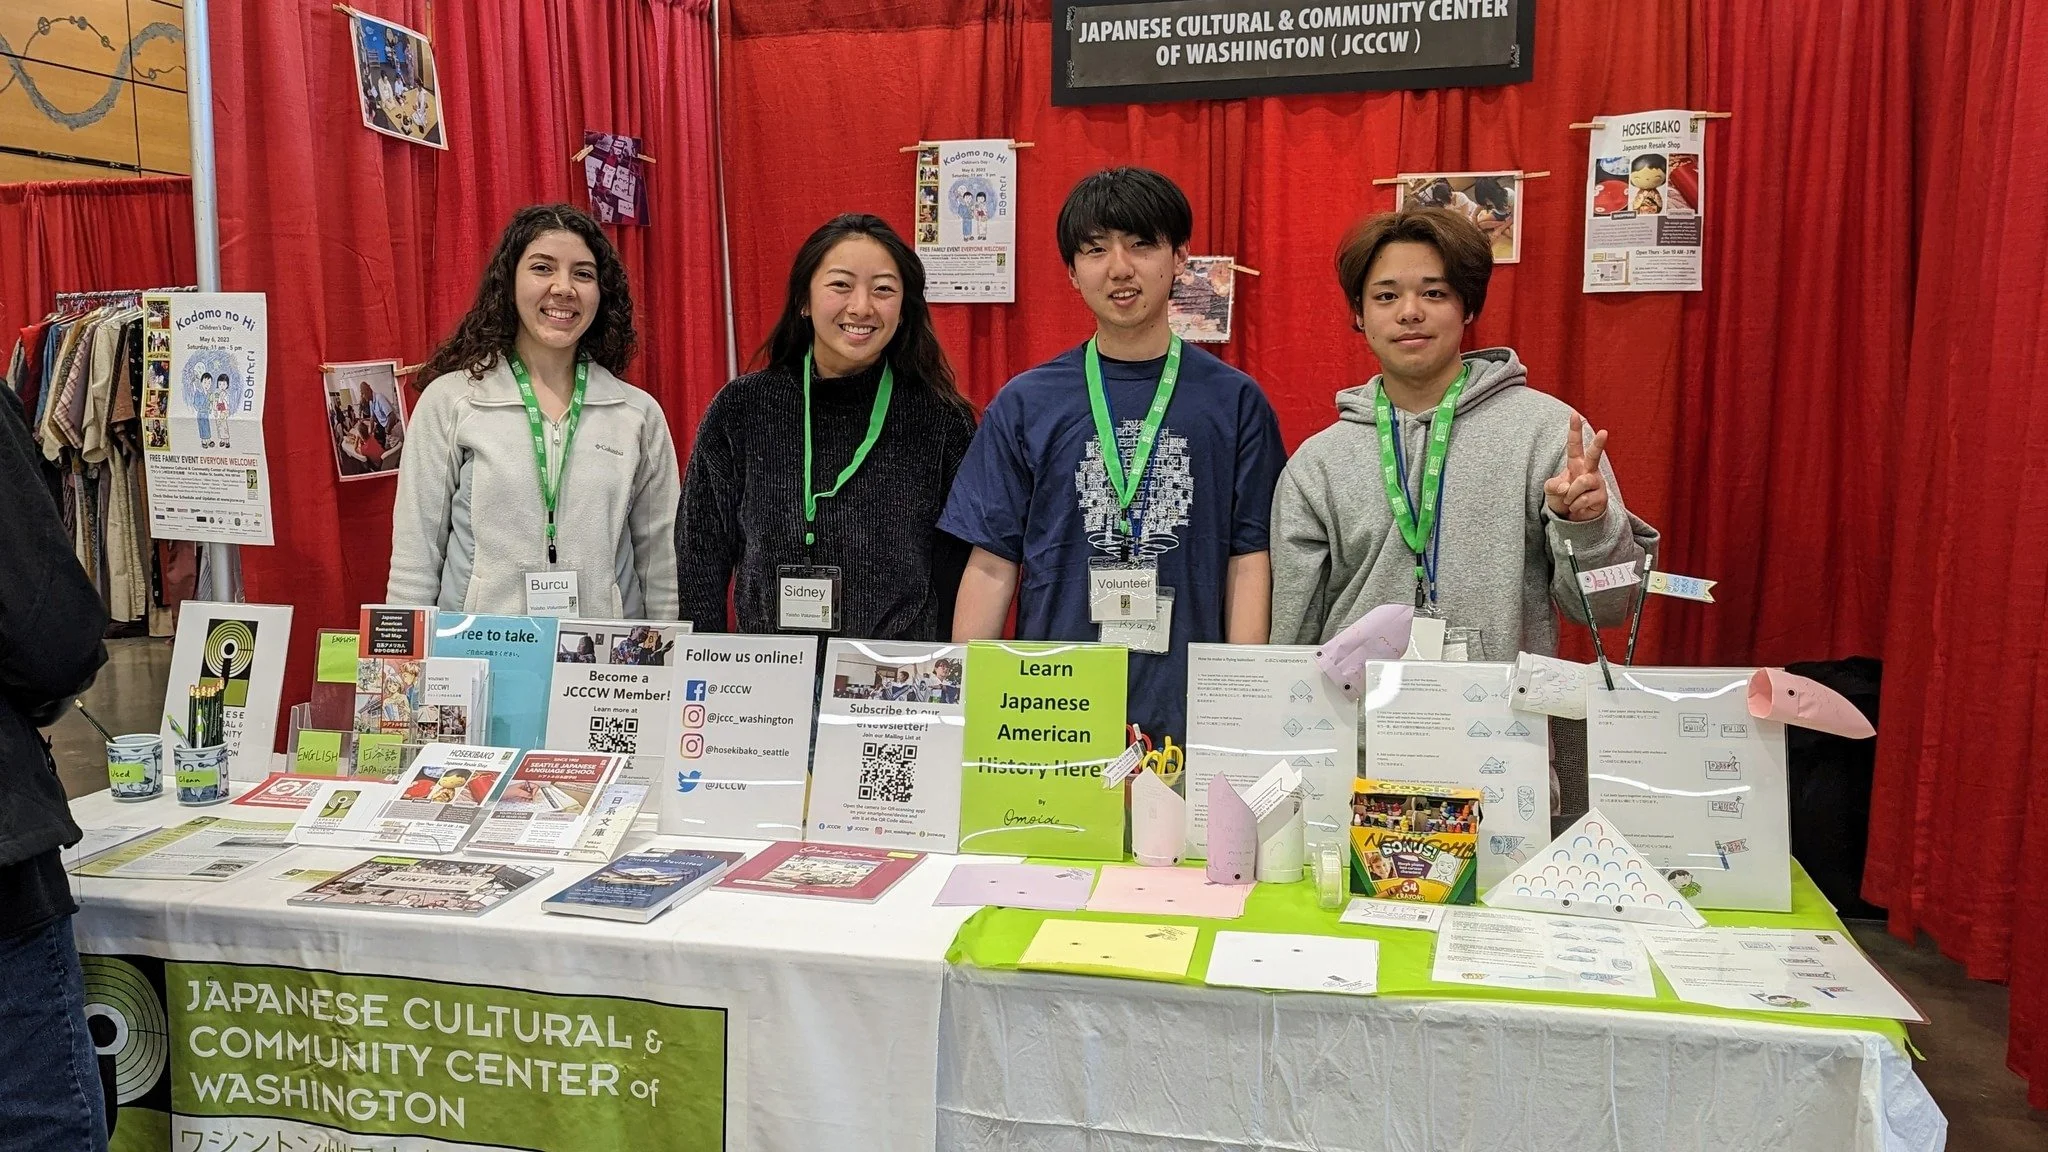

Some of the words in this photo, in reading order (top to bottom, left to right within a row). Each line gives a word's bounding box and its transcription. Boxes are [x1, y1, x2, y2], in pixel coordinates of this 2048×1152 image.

[1078, 18, 1171, 43] JAPANESE
[1176, 11, 1274, 35] CULTURAL
[1278, 9, 1295, 32] &
[1298, 0, 1424, 30] COMMUNITY
[1428, 0, 1508, 22] CENTER
[1156, 44, 1181, 66] OF
[1186, 36, 1325, 64] WASHINGTON
[1341, 32, 1409, 56] JCCCW
[1621, 120, 1681, 137] HOSEKIBAKO
[1622, 143, 1647, 152] Japanese
[1649, 141, 1666, 149] Resale
[1667, 141, 1681, 149] Shop
[943, 150, 980, 165] Kodomo
[997, 154, 1008, 165] Hi
[998, 175, 1008, 216] こどもの日
[176, 309, 221, 331] Kodomo
[225, 310, 239, 322] no
[242, 315, 256, 331] Hi
[243, 350, 256, 412] こどもの日
[149, 454, 161, 462] FREE
[162, 454, 181, 463] FAMILY
[181, 455, 199, 465] EVENT
[200, 456, 228, 466] EVERYONE
[229, 458, 258, 467] WELCOME!
[531, 579, 568, 590] Burcu
[1098, 579, 1151, 589] Volunteer
[784, 585, 826, 600] Sidney
[454, 630, 483, 641] ree
[487, 629, 501, 641] to
[505, 629, 538, 643] take.
[685, 649, 731, 663] Follow
[735, 653, 750, 663] us
[754, 651, 804, 664] online!
[1019, 659, 1073, 677] Learn
[589, 670, 638, 683] Become
[642, 675, 649, 683] a
[563, 686, 610, 698] JCCCW
[613, 688, 671, 700] Member!
[719, 684, 752, 694] JCCCW
[849, 703, 902, 715] Subscribe
[999, 692, 1090, 713] Japanese
[707, 712, 794, 726] @jccc_washington
[997, 724, 1091, 743] American
[297, 750, 339, 763] ENGLISH
[363, 749, 398, 762] 日本語
[449, 749, 495, 760] HOSEKIBAKO
[705, 745, 790, 758] @hosekibako_seattle
[110, 770, 131, 778] Used
[358, 765, 398, 775] JAPANESE
[978, 756, 1050, 779] History
[178, 775, 201, 783] Clean
[1378, 783, 1452, 793] Crayola
[592, 796, 623, 837] 日系文庫
[1003, 808, 1073, 829] Omoide
[1382, 841, 1438, 860] BONUS!
[391, 875, 426, 884] HUNT
[432, 877, 473, 885] HOTEL
[1402, 881, 1418, 893] 64
[1396, 893, 1425, 901] CRAYONS
[187, 979, 390, 1029] JAPANESE
[403, 997, 633, 1051] CULTURAL
[643, 1029, 663, 1054] &
[188, 1026, 432, 1076] COMMUNITY
[445, 1048, 620, 1098] CENTER
[629, 1078, 661, 1108] of
[190, 1072, 466, 1129] WASHINGTON
